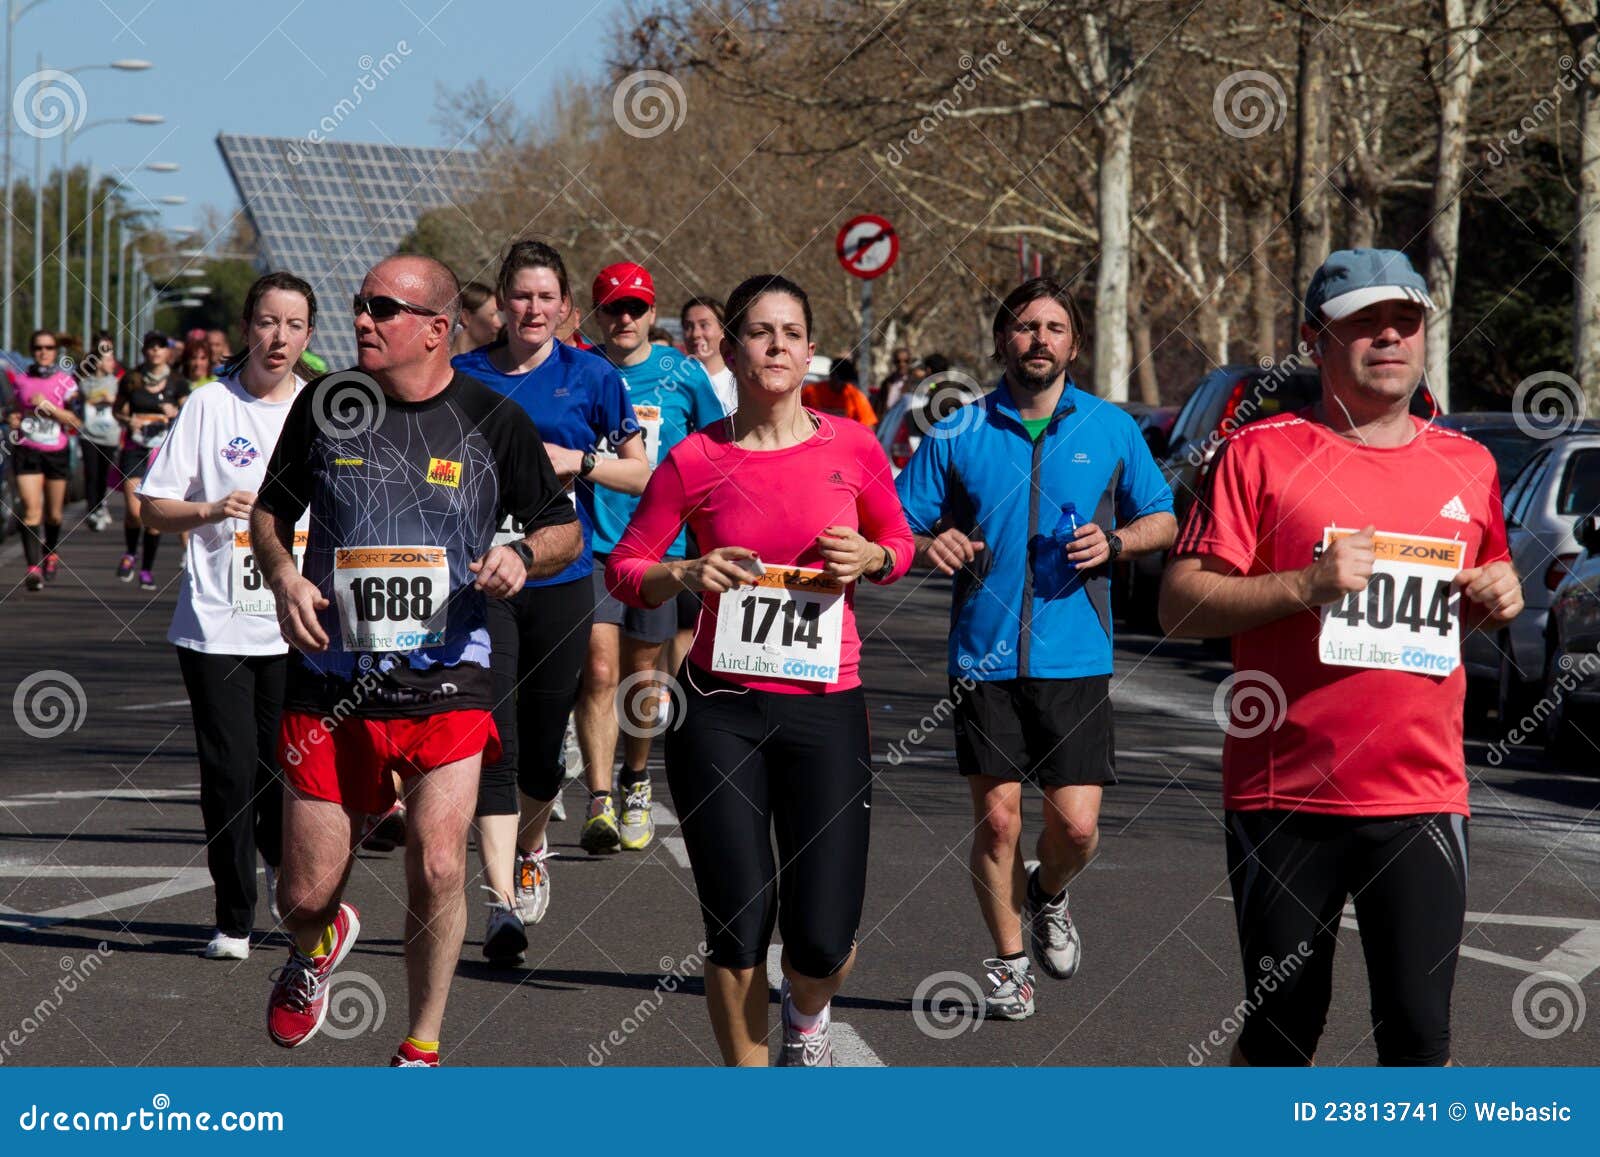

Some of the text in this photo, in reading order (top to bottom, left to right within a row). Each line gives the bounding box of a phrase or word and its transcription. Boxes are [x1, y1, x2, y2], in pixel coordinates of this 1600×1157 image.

[389, 553, 440, 563] ZONE
[1400, 545, 1456, 562] ZONE
[350, 576, 432, 622] 1688
[1331, 572, 1453, 637] 4044
[741, 595, 822, 649] 1714
[716, 651, 836, 679] AireLibre correr
[1323, 640, 1456, 670] AireLibre correr
